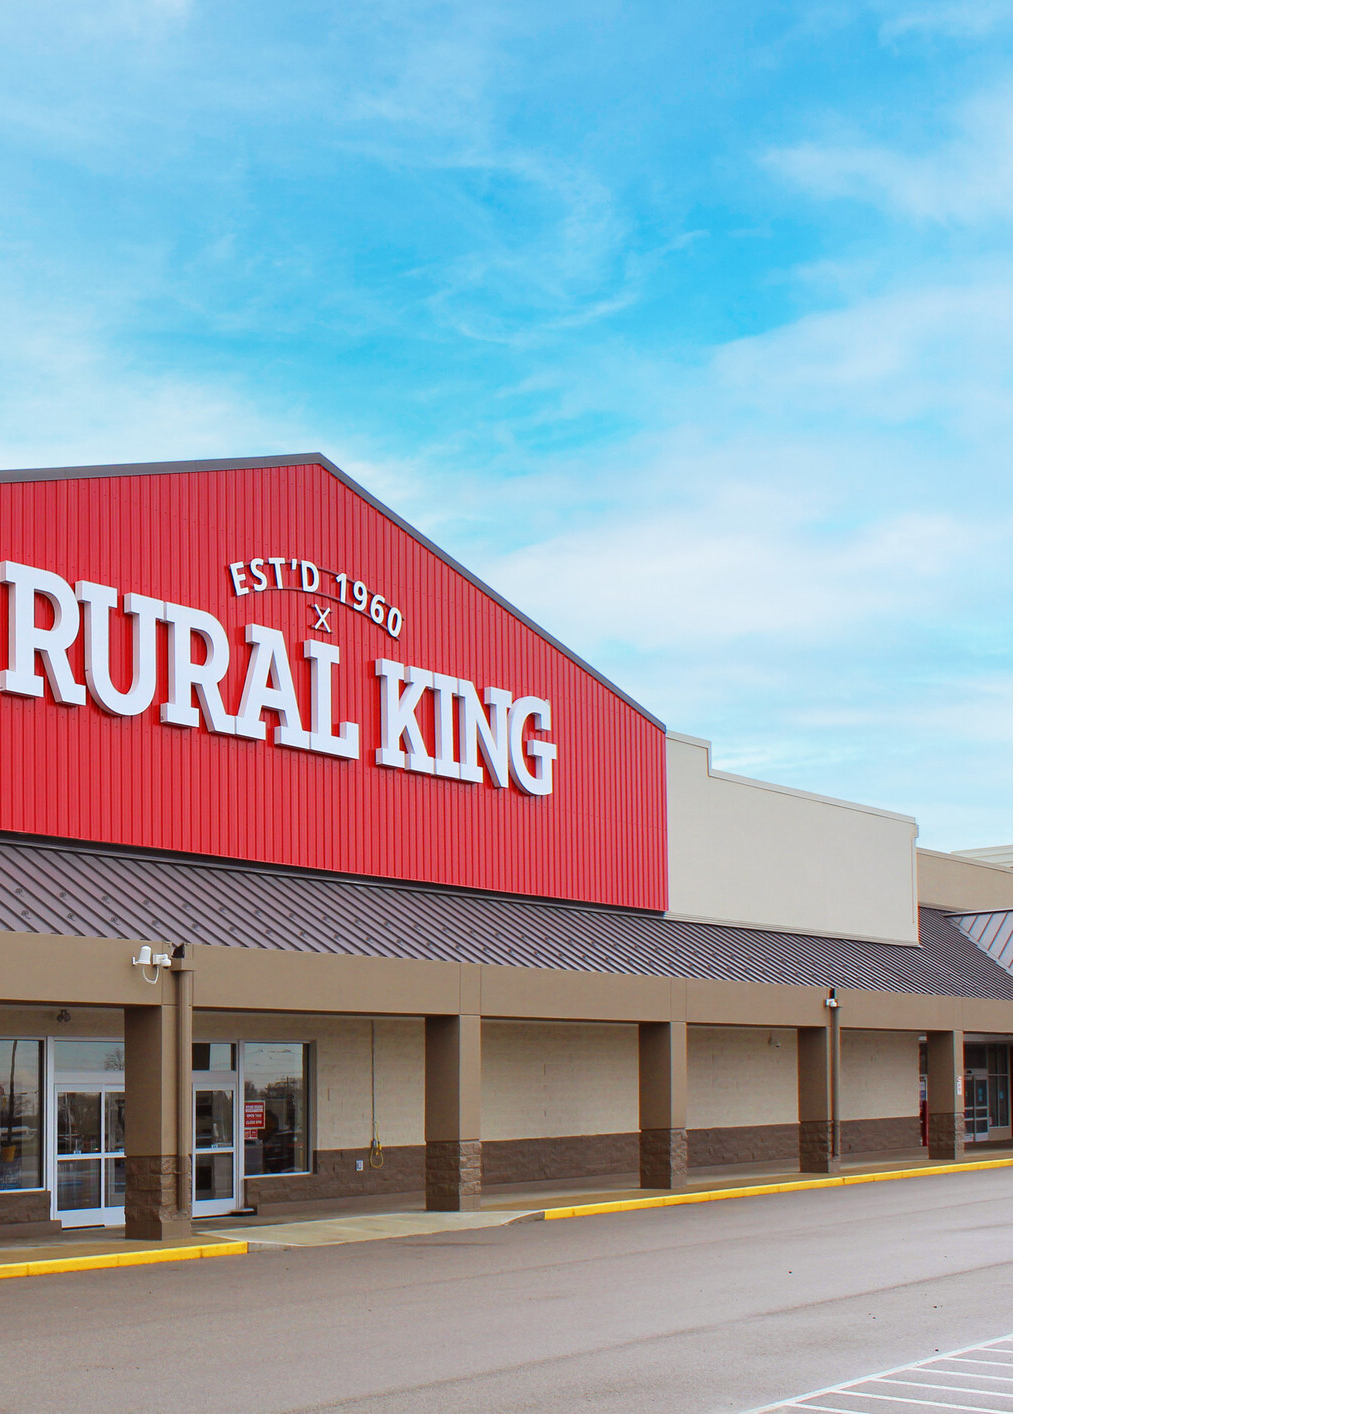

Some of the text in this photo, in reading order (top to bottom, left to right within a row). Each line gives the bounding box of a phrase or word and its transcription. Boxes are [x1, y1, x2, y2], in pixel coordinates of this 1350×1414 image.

[229, 557, 403, 638] EST'D 1960
[375, 657, 558, 797] KING
